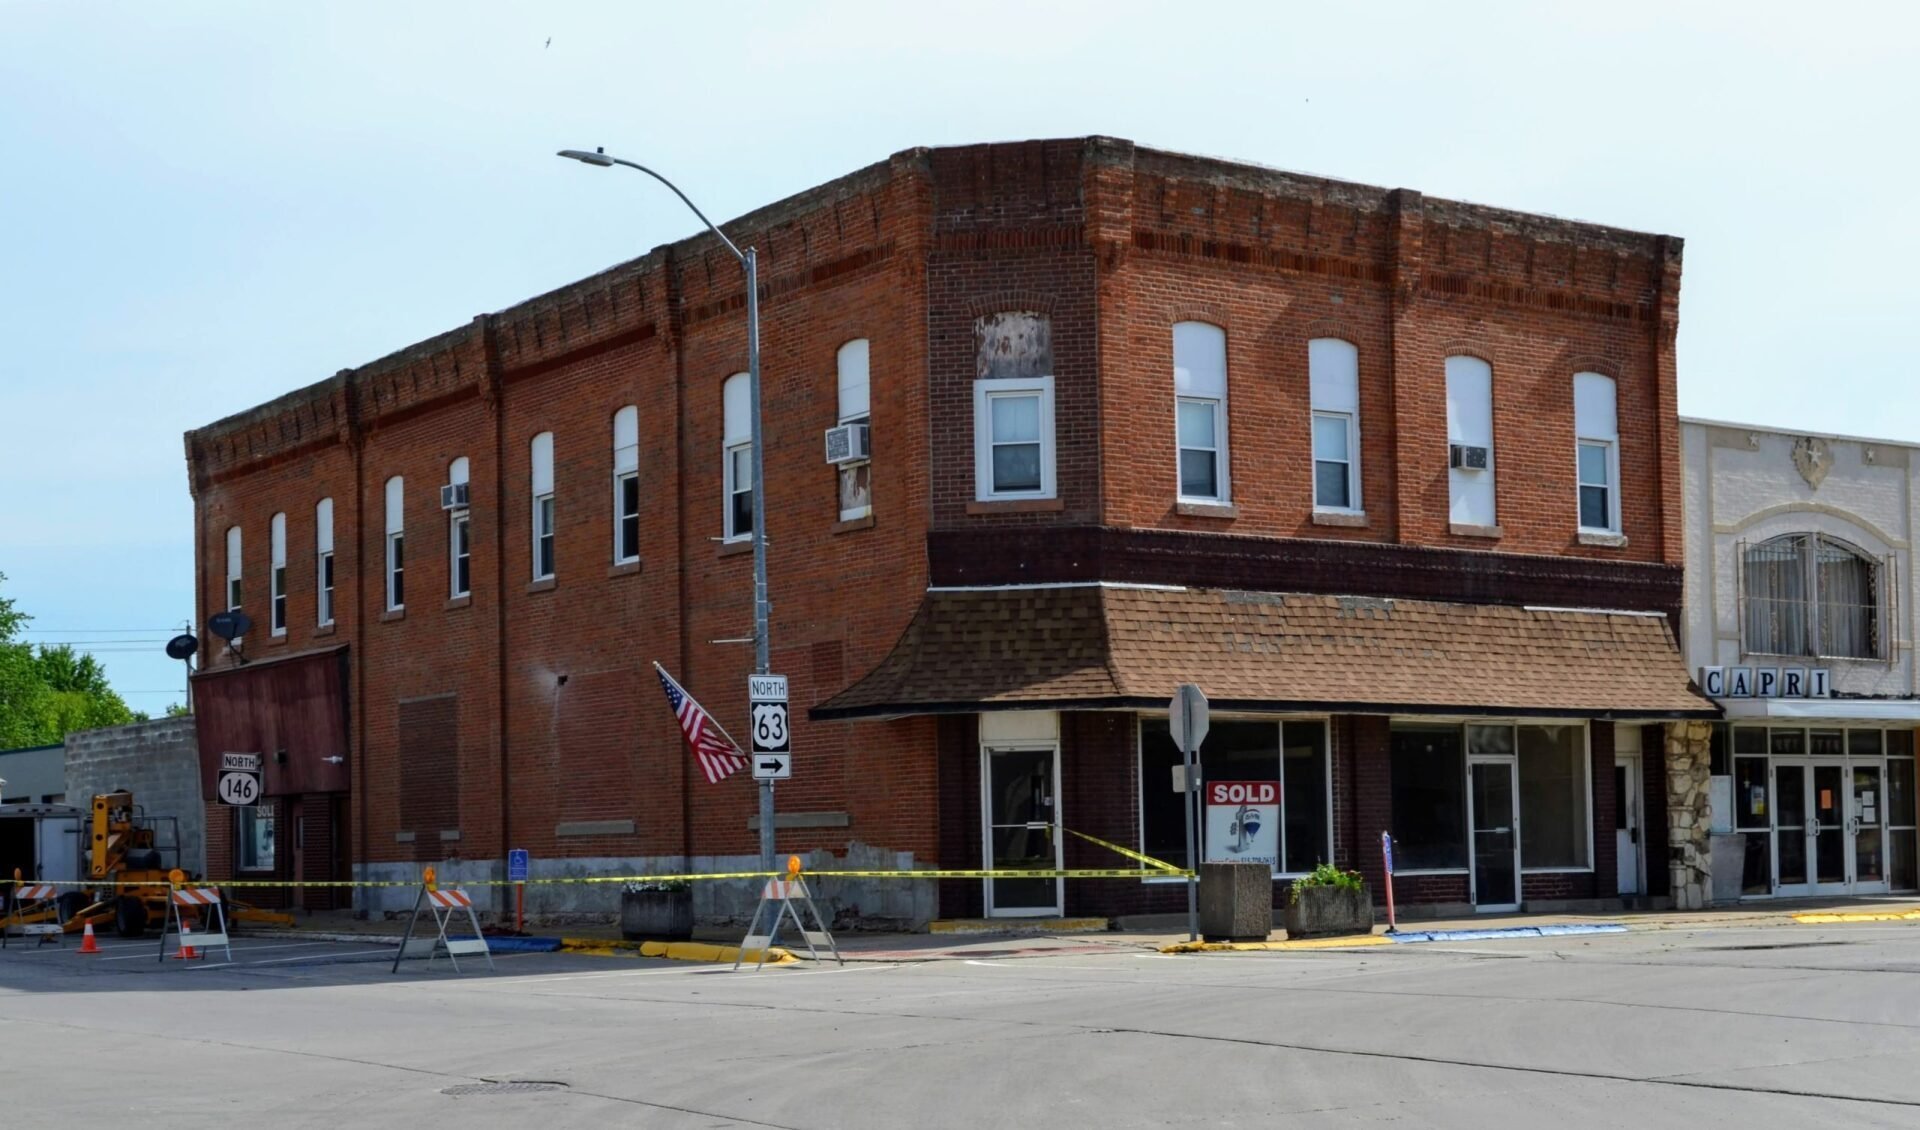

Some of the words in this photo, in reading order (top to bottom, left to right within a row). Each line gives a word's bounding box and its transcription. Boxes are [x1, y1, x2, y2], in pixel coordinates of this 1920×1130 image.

[752, 681, 785, 696] NORTH
[1707, 672, 1825, 695] CAPRI
[758, 713, 783, 740] 63
[225, 756, 255, 767] NORTH
[227, 779, 252, 798] 146
[1214, 784, 1275, 803] SOLD
[256, 805, 274, 817] SOL
